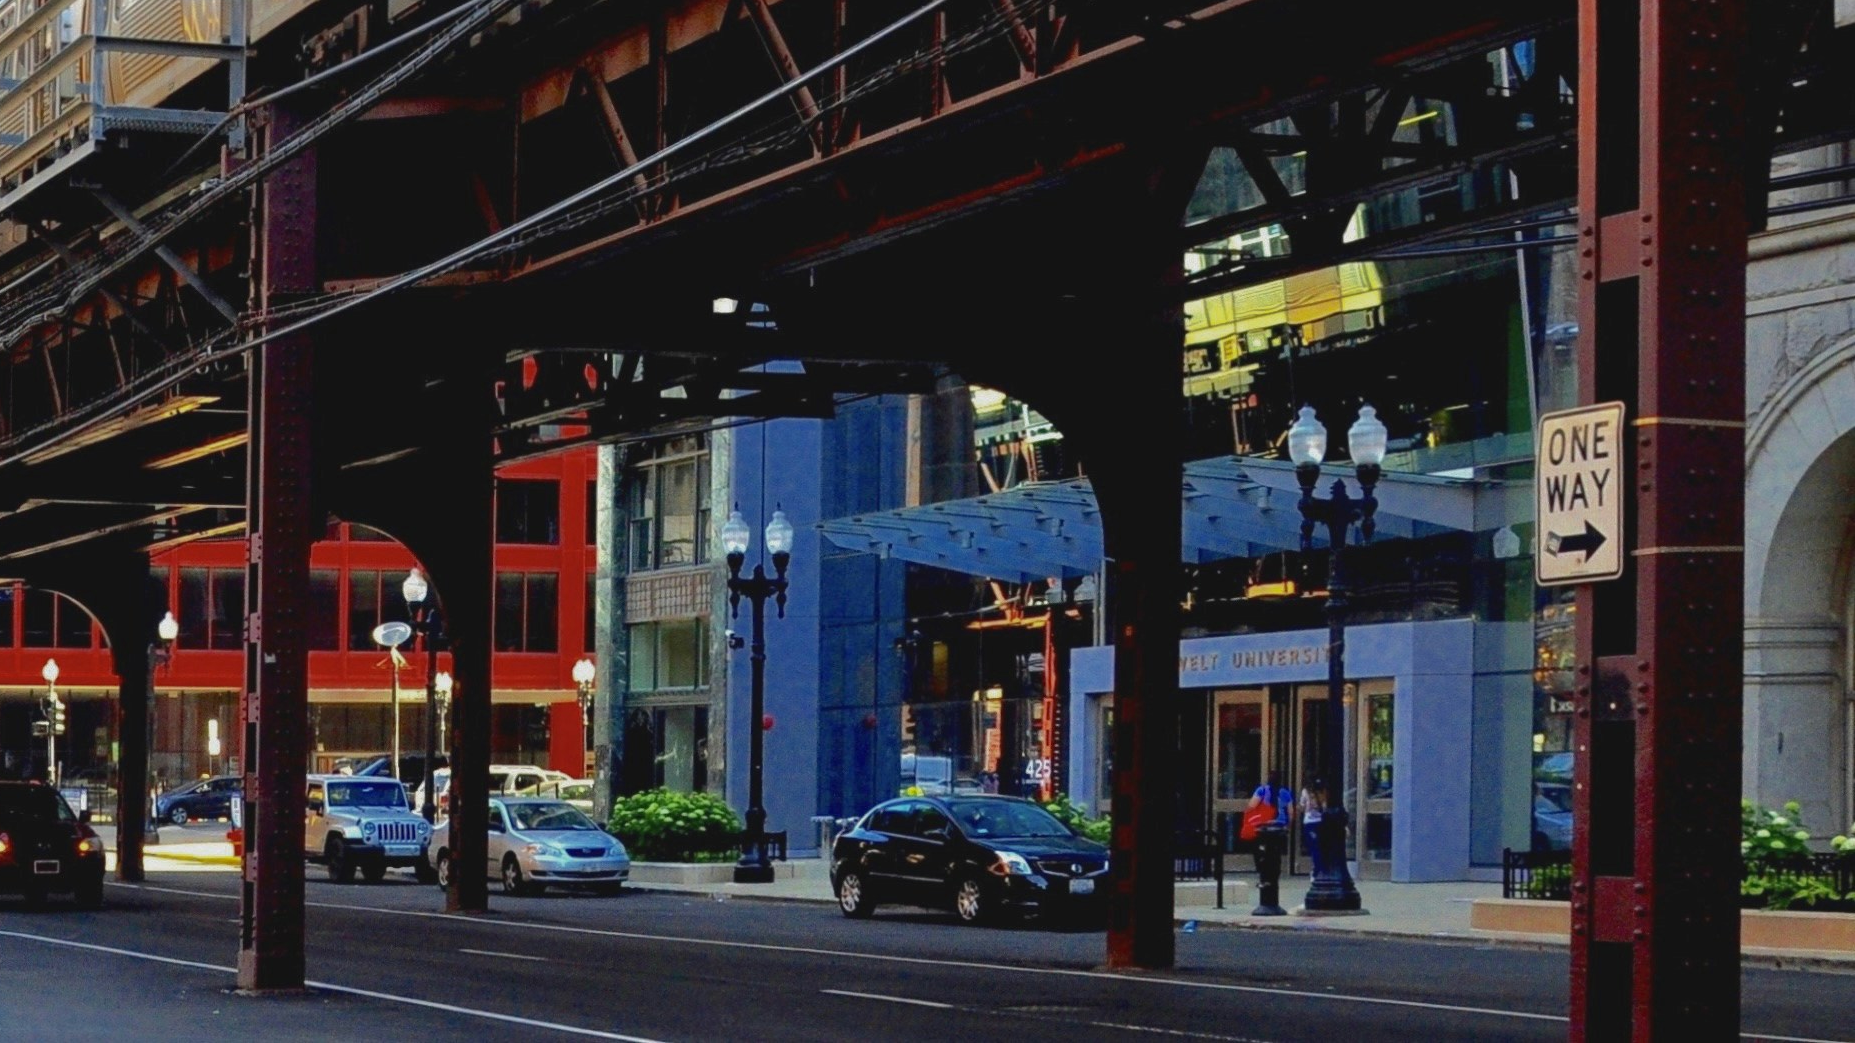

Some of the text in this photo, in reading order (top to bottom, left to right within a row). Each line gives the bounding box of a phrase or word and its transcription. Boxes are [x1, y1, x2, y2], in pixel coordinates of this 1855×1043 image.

[1548, 421, 1610, 466] ONE
[1546, 469, 1611, 514] WAY
[1232, 646, 1332, 669] UNIVERSIT
[1025, 759, 1052, 779] 425
